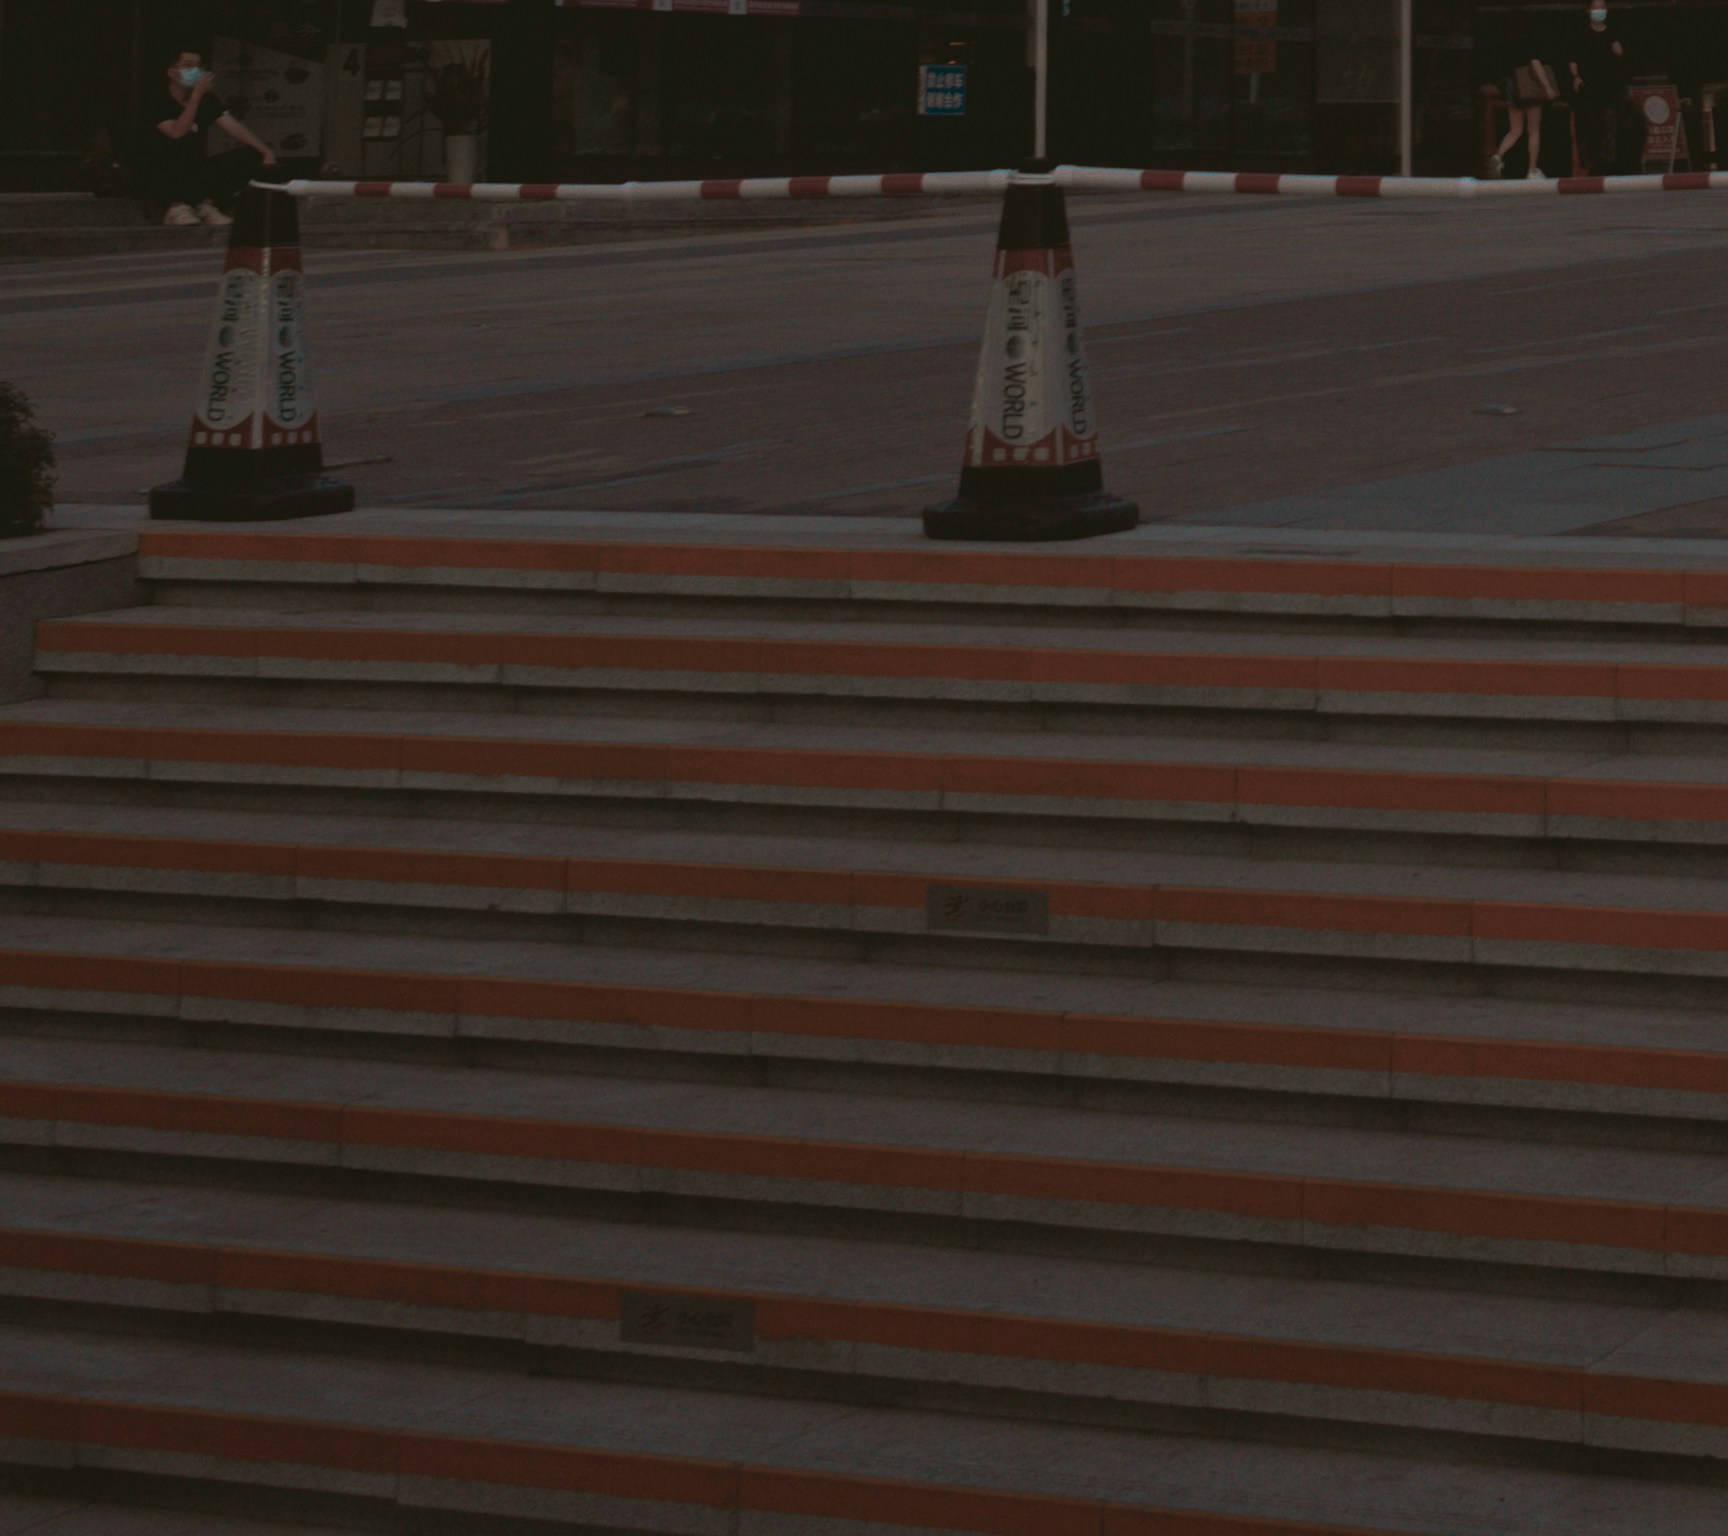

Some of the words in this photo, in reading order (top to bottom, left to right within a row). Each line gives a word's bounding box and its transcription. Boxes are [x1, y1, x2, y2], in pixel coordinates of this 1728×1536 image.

[207, 351, 233, 422] WORLD
[279, 351, 297, 422] WORLD
[1001, 363, 1027, 440] WORLD
[1068, 359, 1088, 435] WORLD
